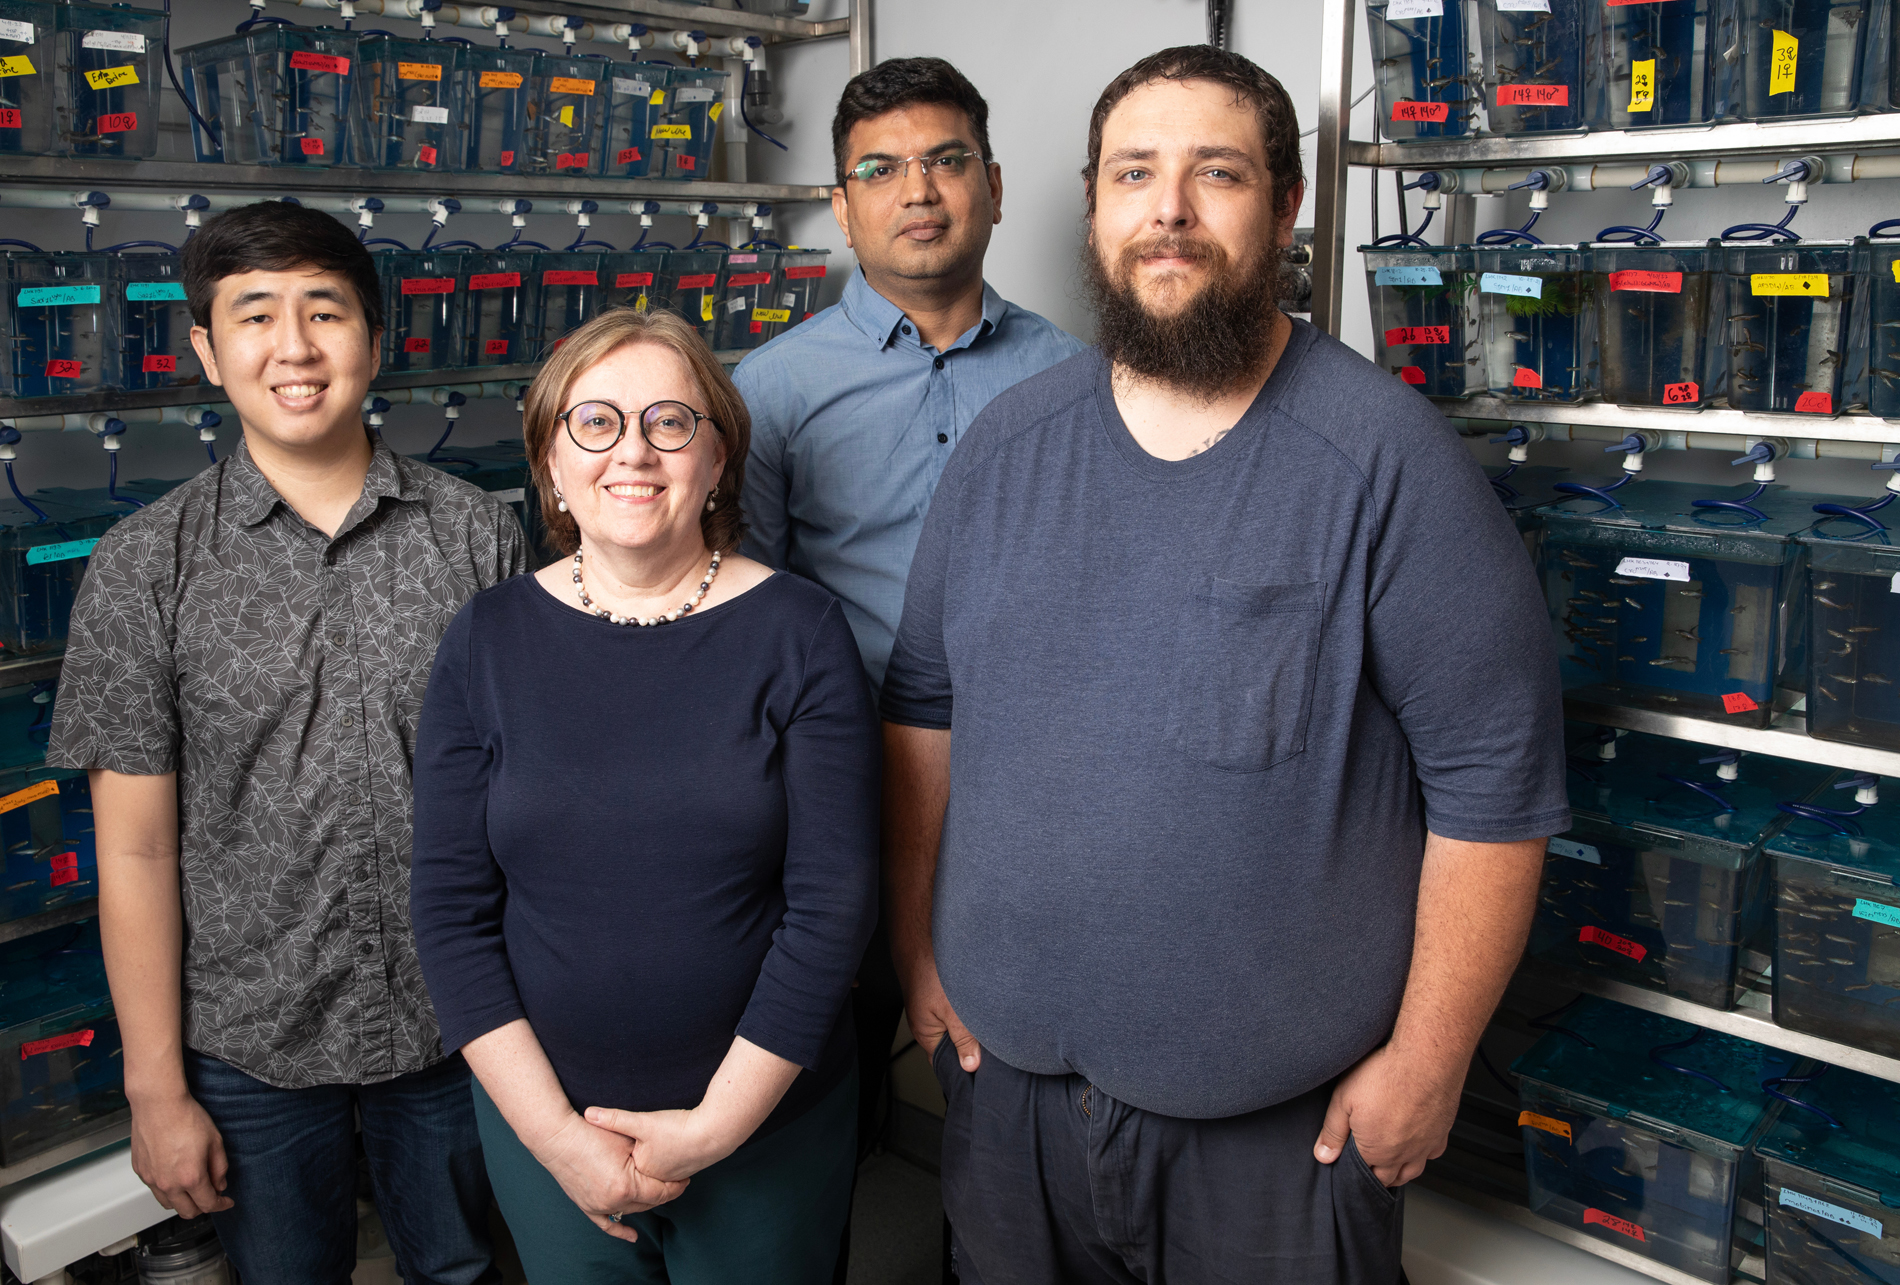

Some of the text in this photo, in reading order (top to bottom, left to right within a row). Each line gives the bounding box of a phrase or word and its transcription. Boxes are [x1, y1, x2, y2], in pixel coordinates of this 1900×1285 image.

[1401, 327, 1416, 344] 26
[56, 361, 75, 374] 32
[156, 358, 171, 369] 32
